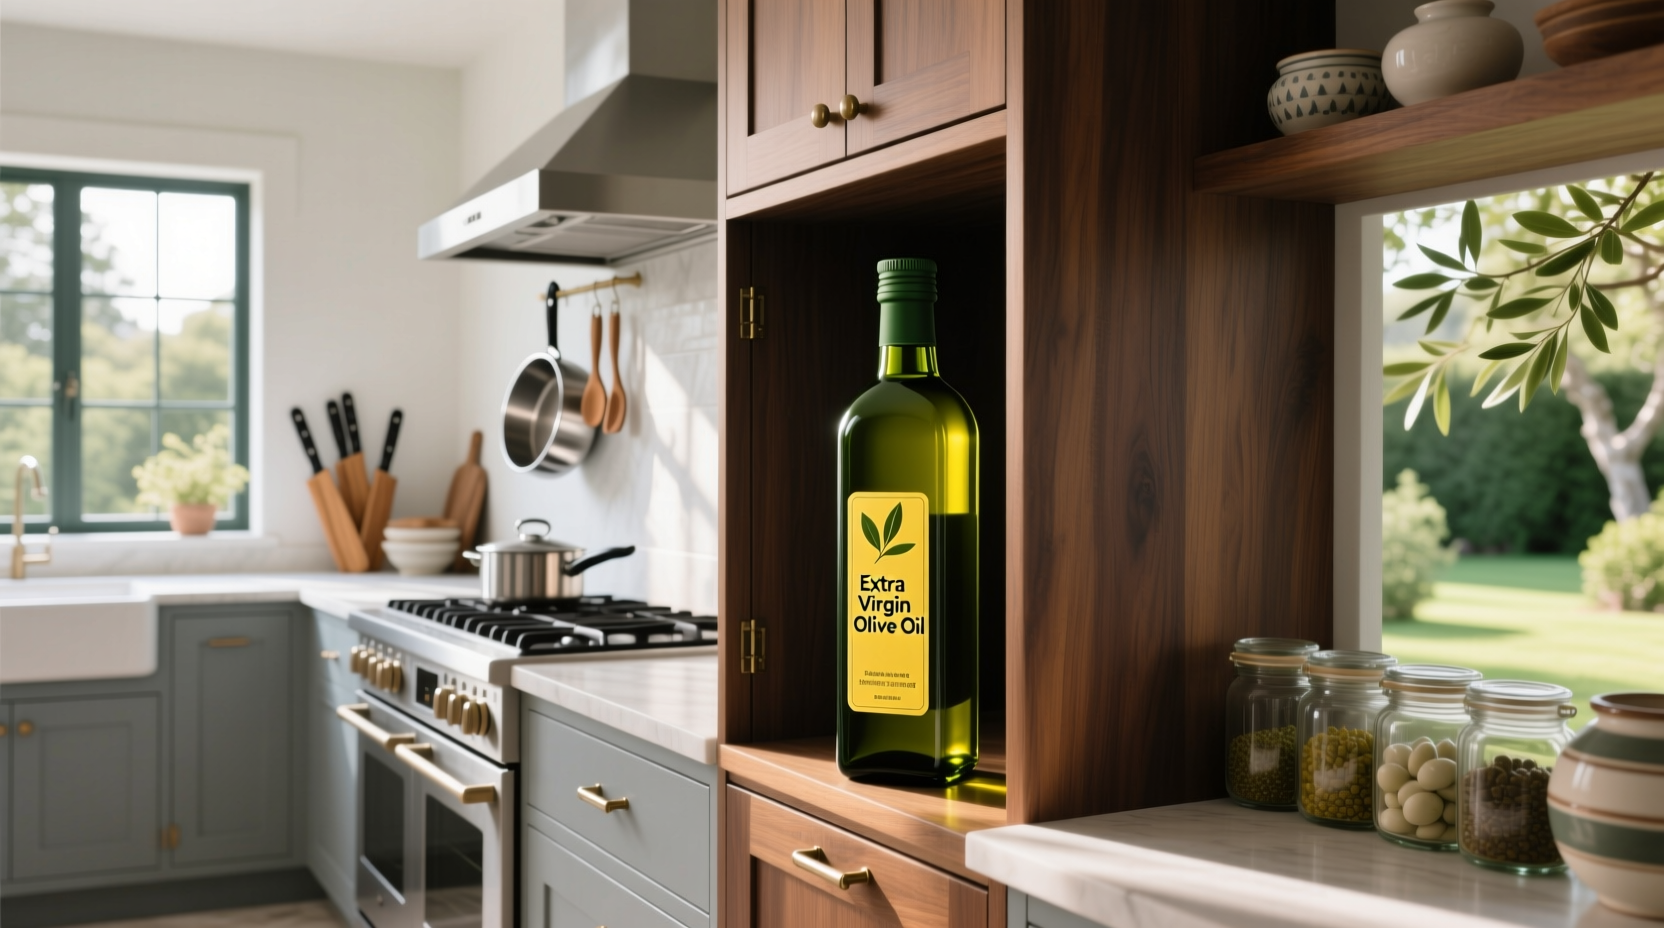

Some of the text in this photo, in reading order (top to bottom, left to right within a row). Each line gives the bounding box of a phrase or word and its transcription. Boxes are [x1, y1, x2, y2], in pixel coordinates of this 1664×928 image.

[860, 574, 905, 592] Extra
[858, 595, 911, 617] Virgin
[854, 616, 925, 635] Olive Oil
